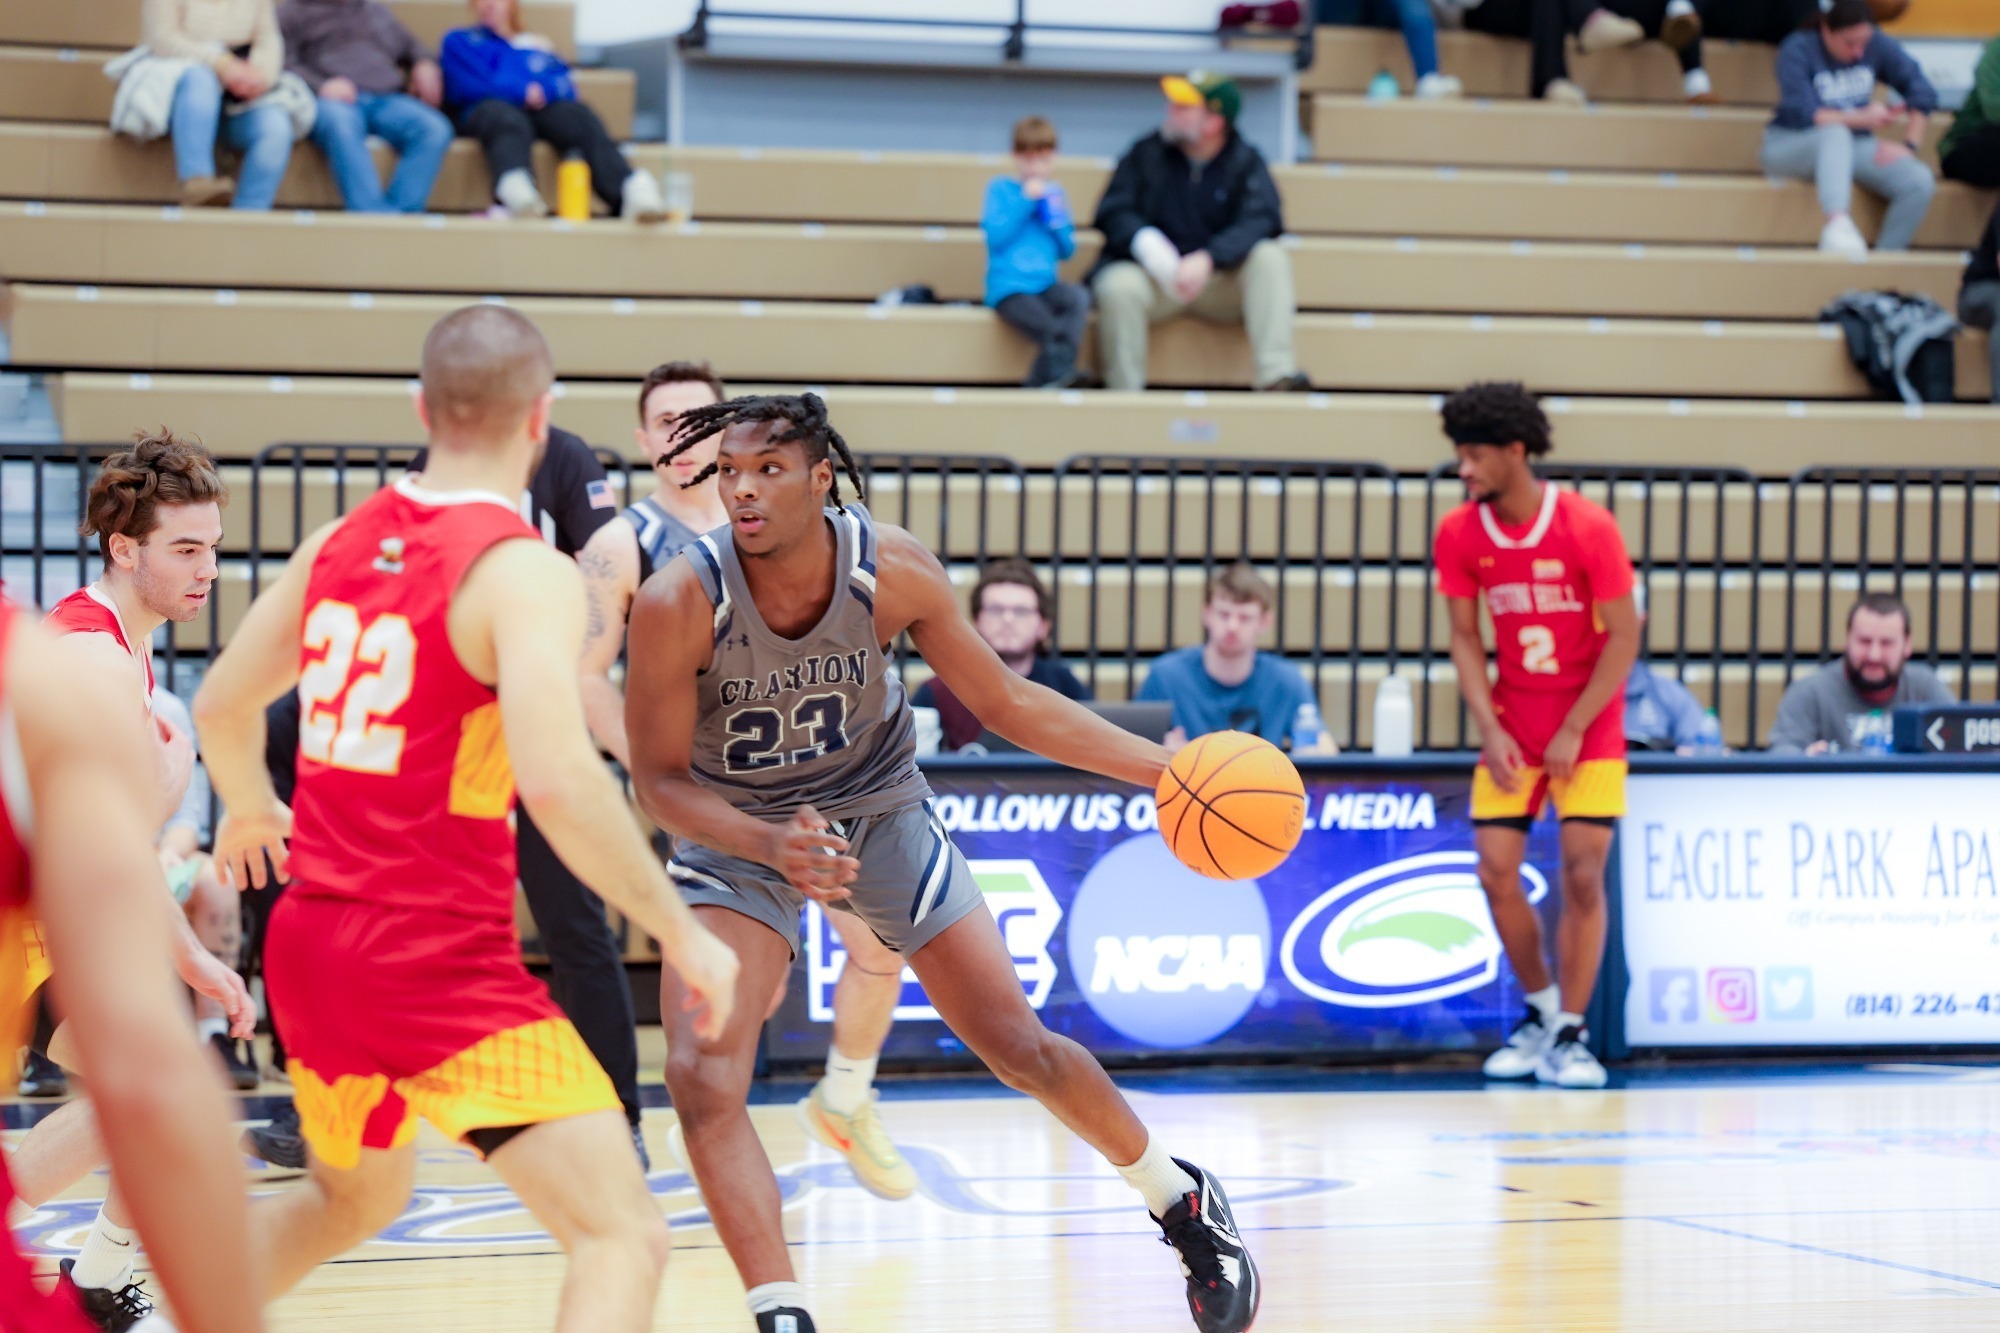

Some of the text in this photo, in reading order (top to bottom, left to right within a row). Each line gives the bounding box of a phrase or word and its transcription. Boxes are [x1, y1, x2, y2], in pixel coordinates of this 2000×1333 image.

[1533, 583, 1584, 614] HILL
[1518, 624, 1559, 675] 2
[298, 598, 418, 777] 22
[719, 648, 868, 708] CLARION
[723, 691, 850, 775] 23
[931, 794, 1158, 832] OLLOW US O
[1319, 792, 1437, 831] MEDIA
[1644, 822, 2000, 902] EAGLE PARK APA
[1091, 935, 1265, 993] NCAA
[1845, 993, 1903, 1019] (814)
